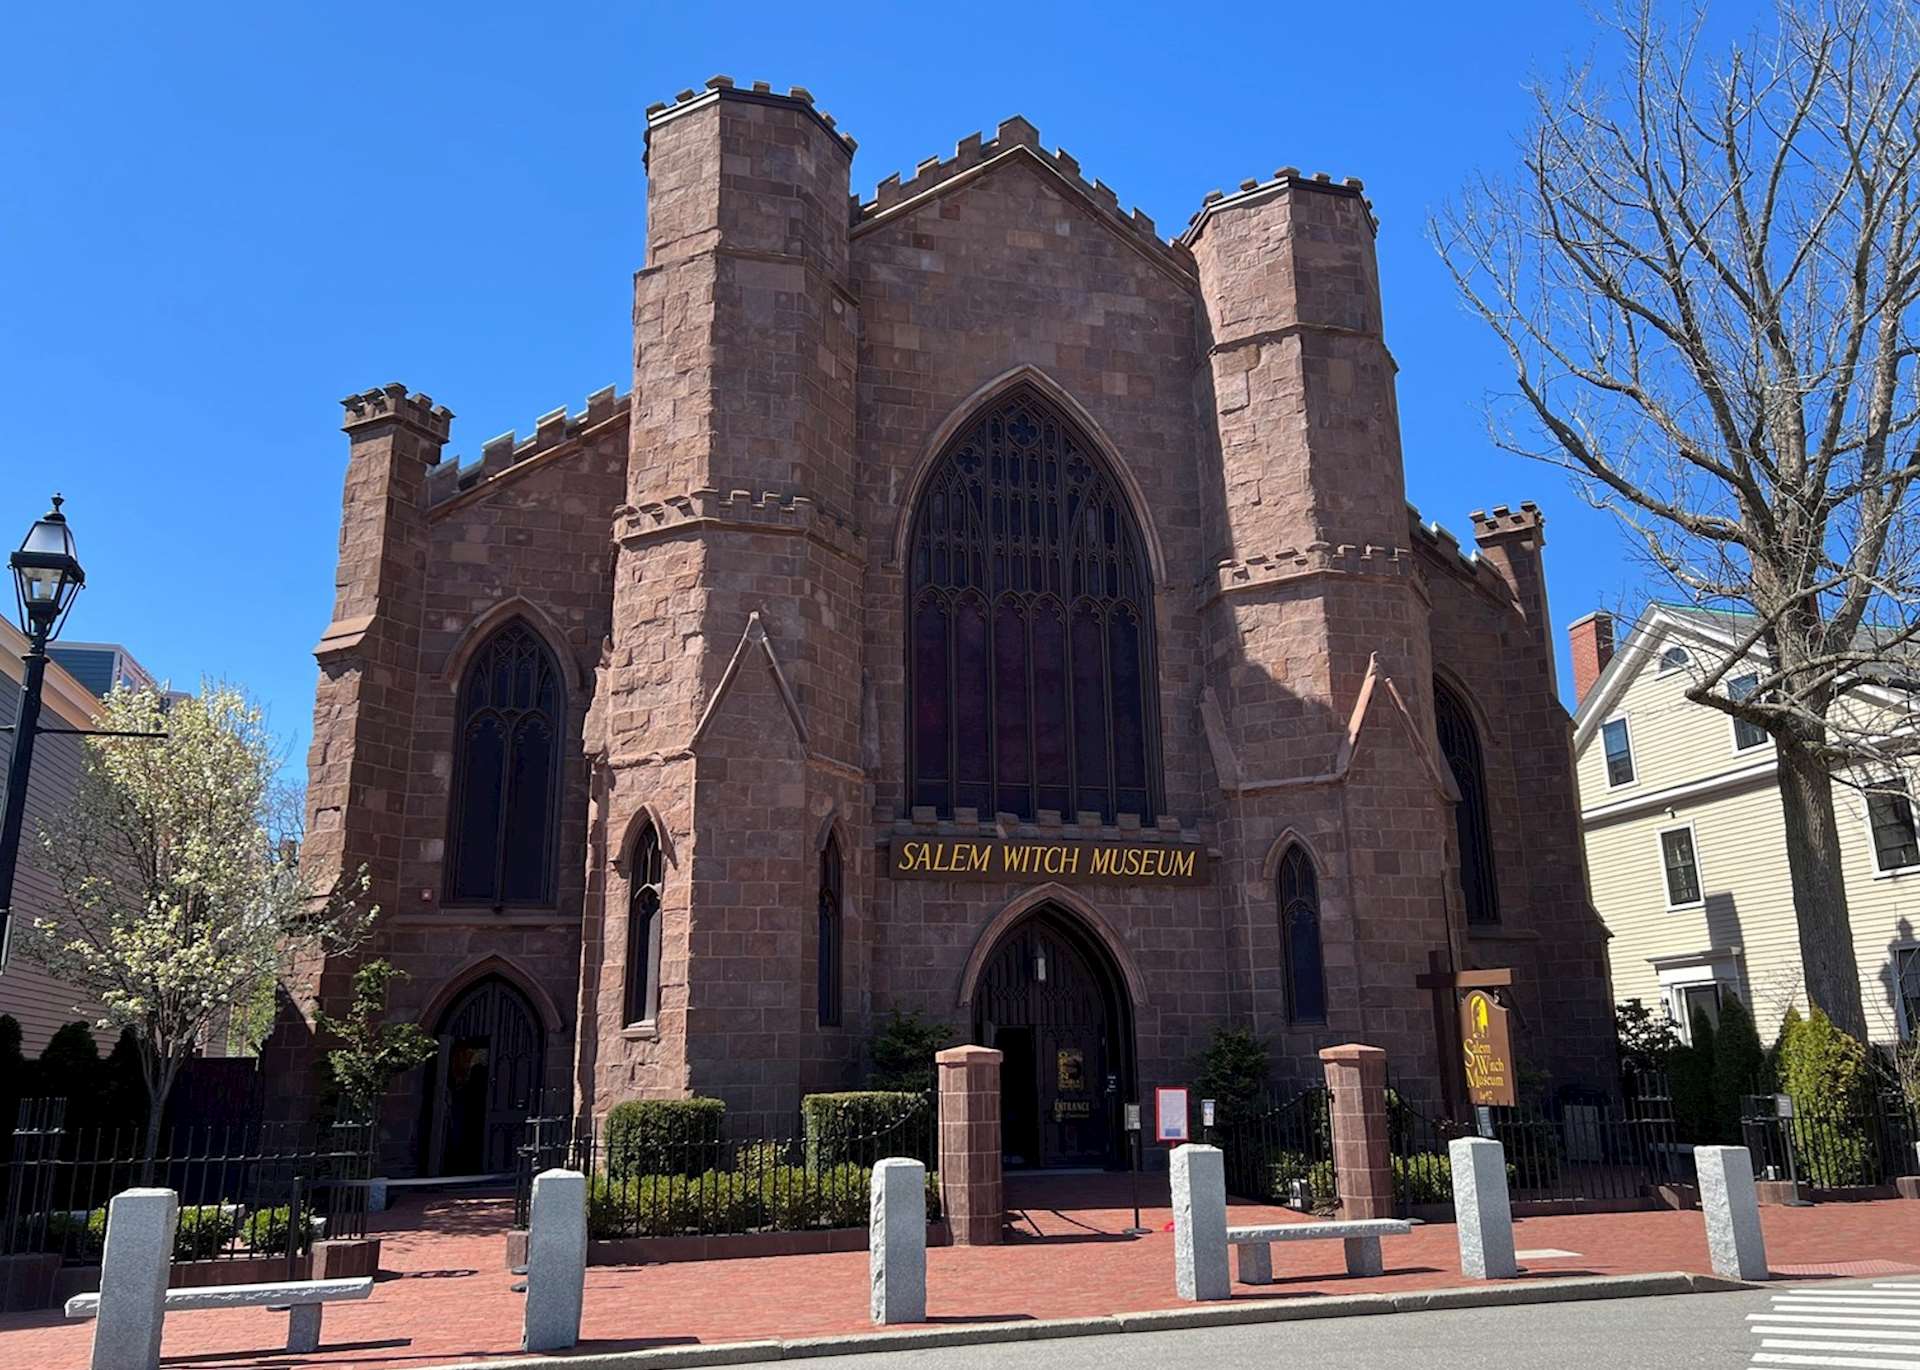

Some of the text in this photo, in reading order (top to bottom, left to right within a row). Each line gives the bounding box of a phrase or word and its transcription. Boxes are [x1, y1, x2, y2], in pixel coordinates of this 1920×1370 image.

[898, 841, 1196, 877] SALEM WITCH MUSEUM
[1463, 1038, 1491, 1068] Salem
[1475, 1054, 1505, 1075] Witch
[1465, 1067, 1505, 1088] Museum
